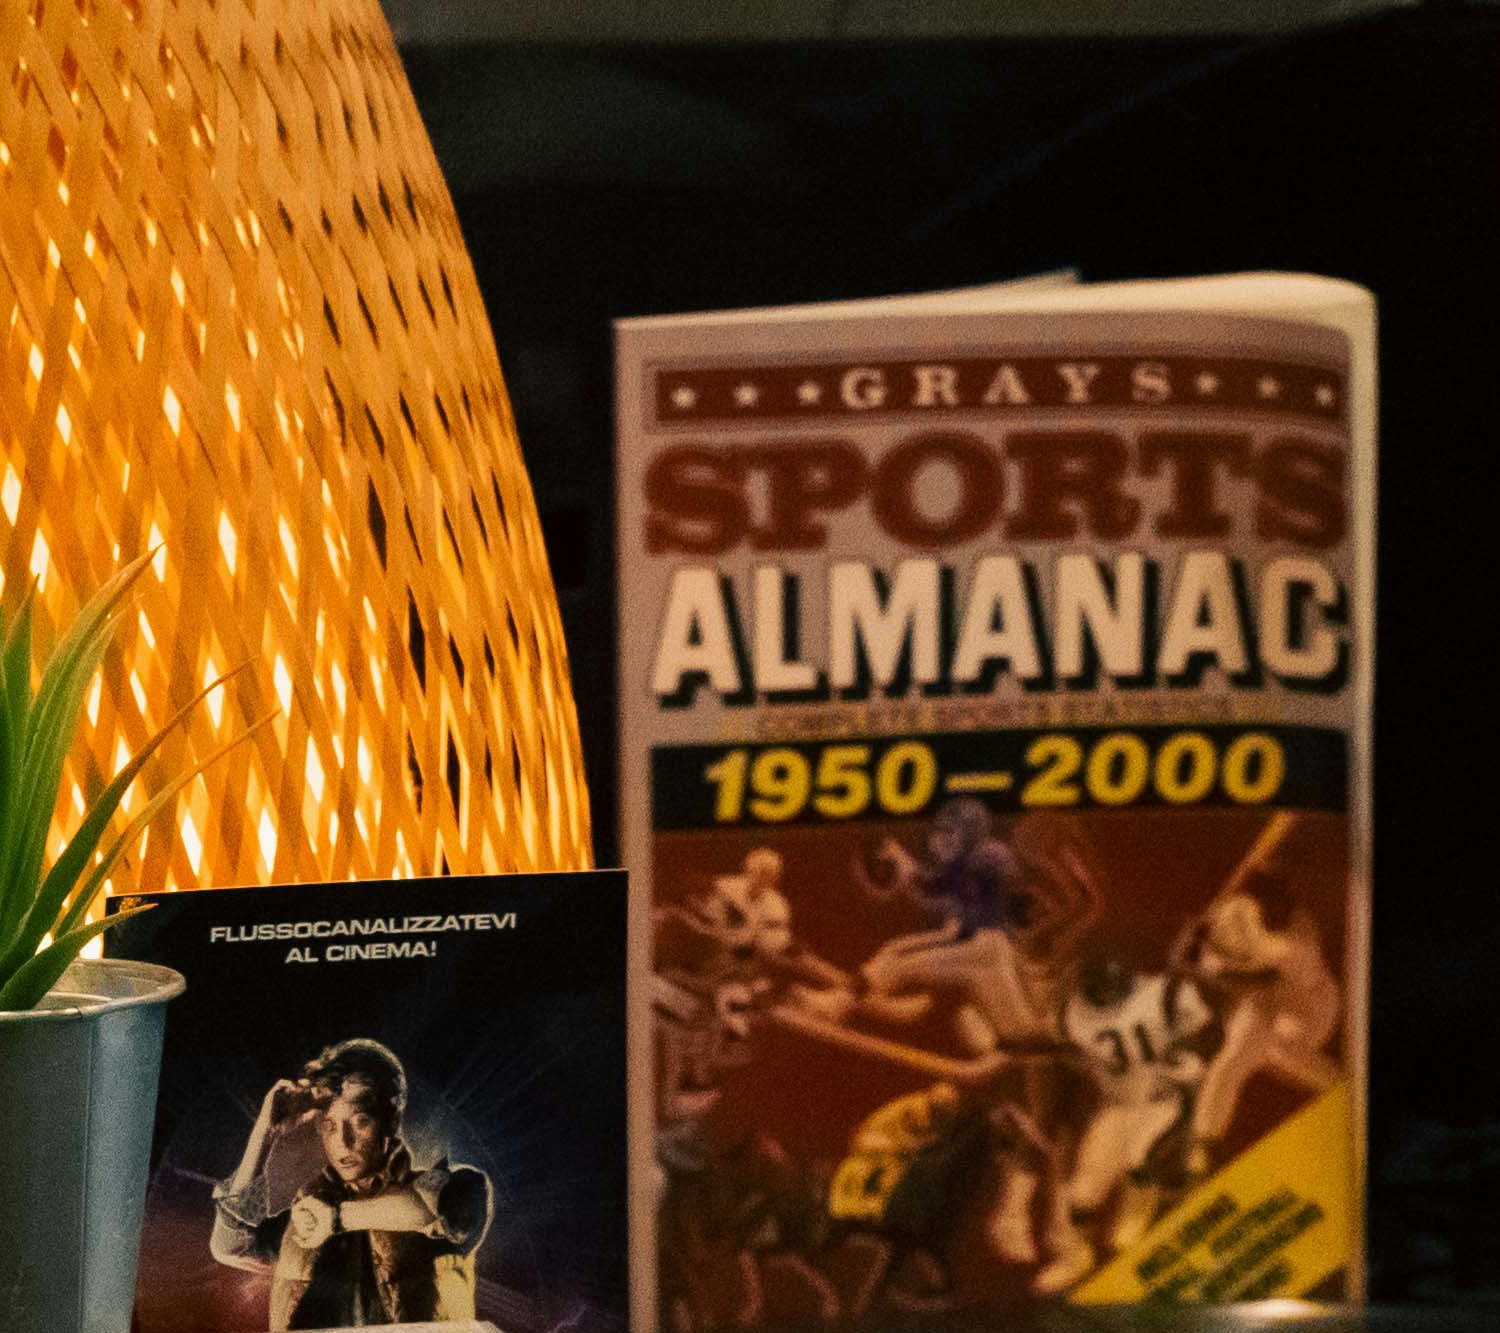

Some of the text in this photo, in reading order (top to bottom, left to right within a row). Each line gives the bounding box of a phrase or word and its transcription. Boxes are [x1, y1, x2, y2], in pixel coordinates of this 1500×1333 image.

[842, 362, 1176, 412] GRAYS
[643, 429, 1350, 555] SPORTS
[652, 550, 1352, 708] ALMANAC
[210, 913, 517, 943] FLUSSOCANALIZZATEVI
[285, 941, 438, 964] AL CINEMA!
